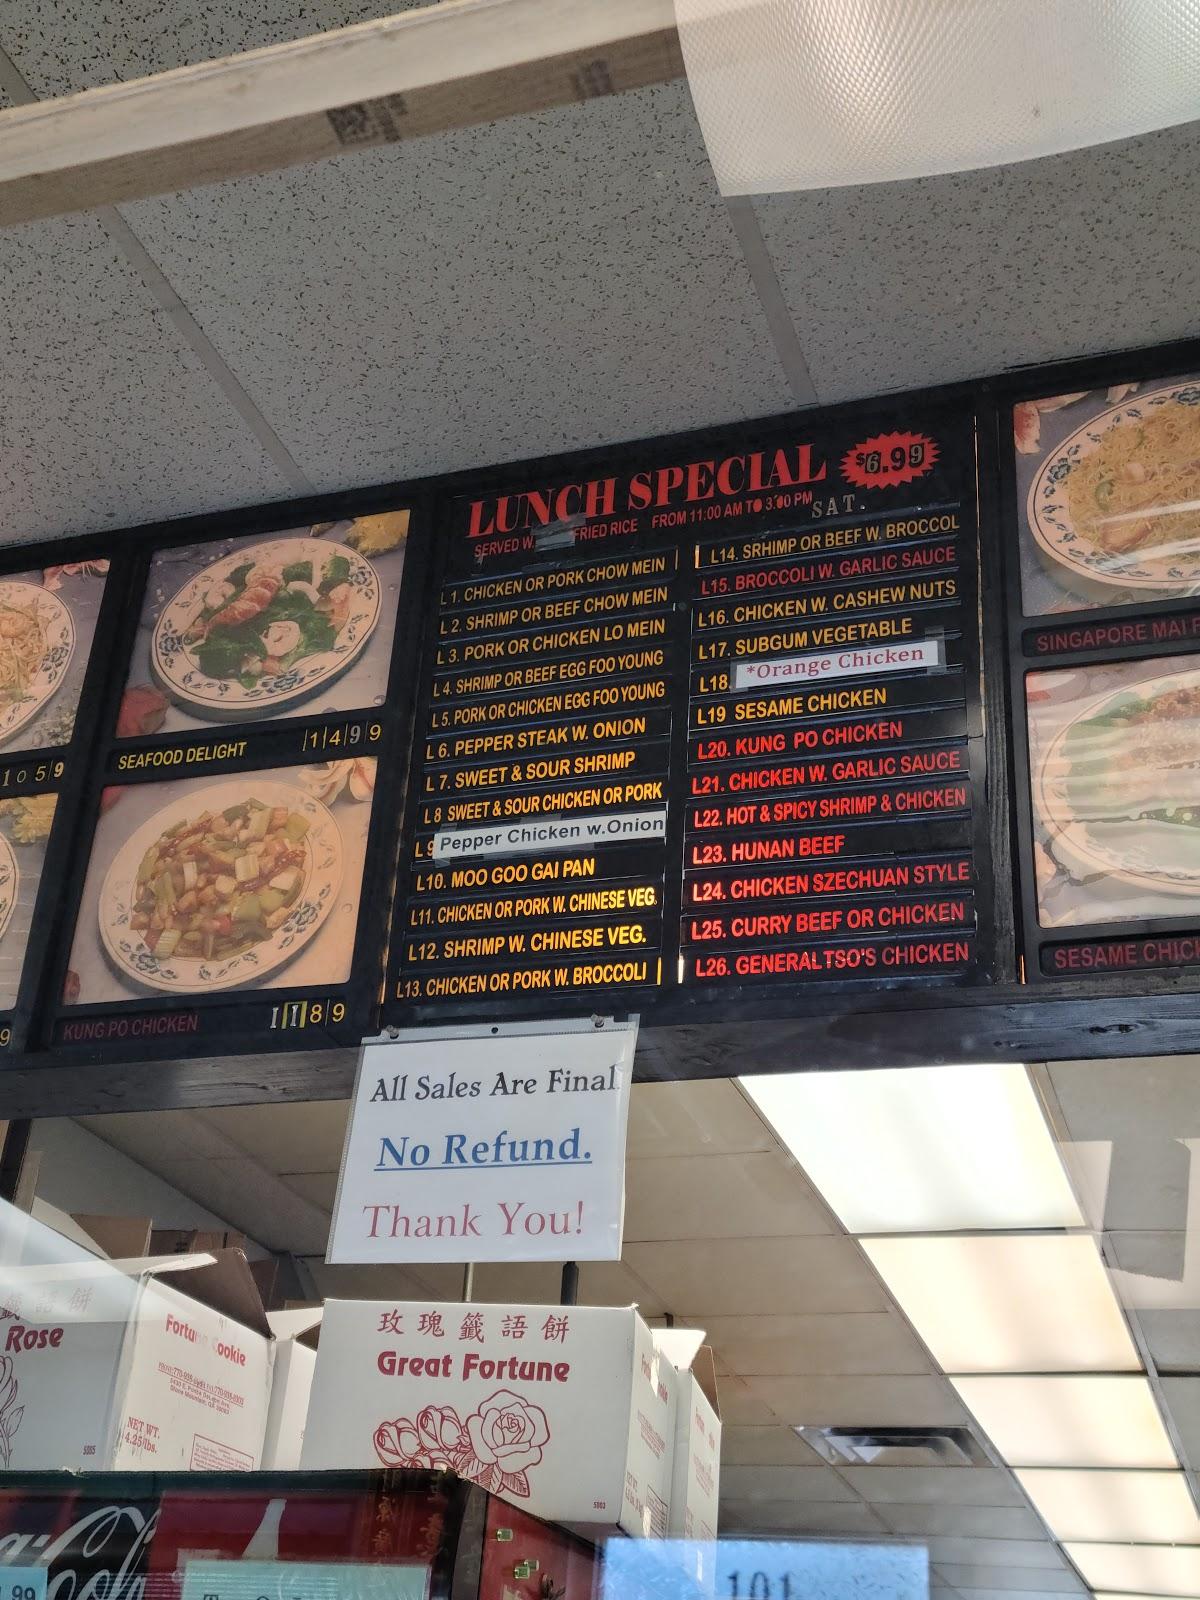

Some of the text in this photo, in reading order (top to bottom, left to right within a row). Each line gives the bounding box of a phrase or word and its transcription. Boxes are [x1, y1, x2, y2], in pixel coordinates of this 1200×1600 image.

[856, 444, 924, 474] $6.99
[465, 443, 826, 538] LUNCH SPECIAL
[474, 491, 813, 558] SERVED RICE FROM AM PM
[711, 514, 960, 564] L14. SRHIMP OR BEEF BROCCOL
[464, 557, 665, 601] CHICKEN OR PORK CHOW MEIN
[701, 546, 955, 596] L15. BROCCOLI GARLIC SAUCE
[466, 586, 668, 631] SHRIMP OR BEEF CHOW MEIN
[698, 579, 955, 628] L16. CHICKEN W. CASHEW NUTS
[464, 619, 665, 661] PORK OR CHICKEN LO MEIN
[698, 618, 912, 660] L17. SUBGUM VEGETABLE
[1037, 622, 1186, 652] SINGAPORE MAI
[456, 650, 664, 694] SHRIMP OR BEEF EGG FOO YOUNG
[838, 647, 924, 667] Chicken
[454, 681, 665, 725] PORK OR CHICKEN EGG FOO YOUNG
[697, 688, 887, 725] L19 SESAME CHICKEN
[455, 717, 646, 756] PEPPER STEAK ONION
[698, 721, 902, 760] L20. KUNG PO CHICKEN
[117, 741, 247, 771] SEAFOOD DELIGHT
[455, 751, 636, 789] SWEET SOUR SHRIMP
[692, 750, 960, 795] L21. CHICKEN W. GARLIC SAUCE
[448, 782, 662, 821] SWEET SOUR CHICKEN OR PORK
[694, 788, 966, 828] L22. HOT SPICY SHRIMP CHICKEN
[440, 834, 502, 851] Pepper
[507, 825, 580, 843] Chicken
[692, 835, 846, 865] L23. HUNAN BEEF
[416, 858, 595, 892] L10. MOO GOO GAI PAN
[692, 862, 970, 902] L24. CHICKEN SZECHUAN STYLE
[410, 890, 625, 926] L11. CHICKEN OR PORK CHINESE
[691, 902, 964, 940] L25. CURRY BEEF OR CHICKEN
[408, 924, 646, 961] L12. SHRIMP W. CHINESE VEG.
[695, 942, 969, 977] L26. GENERAL CHICKEN
[1054, 944, 1137, 969] SESAME
[396, 962, 647, 999] L13. CHICKEN OR PORK BROCCOLI
[63, 1014, 199, 1041] KUNG PO CHICKEN
[369, 1064, 617, 1102] All Sales Are Final
[376, 1127, 592, 1167] No Refund.
[363, 1200, 584, 1238] Thank You!
[5, 1325, 64, 1353] Rose
[377, 1350, 571, 1383] Great Fortune
[128, 1416, 144, 1432] NET
